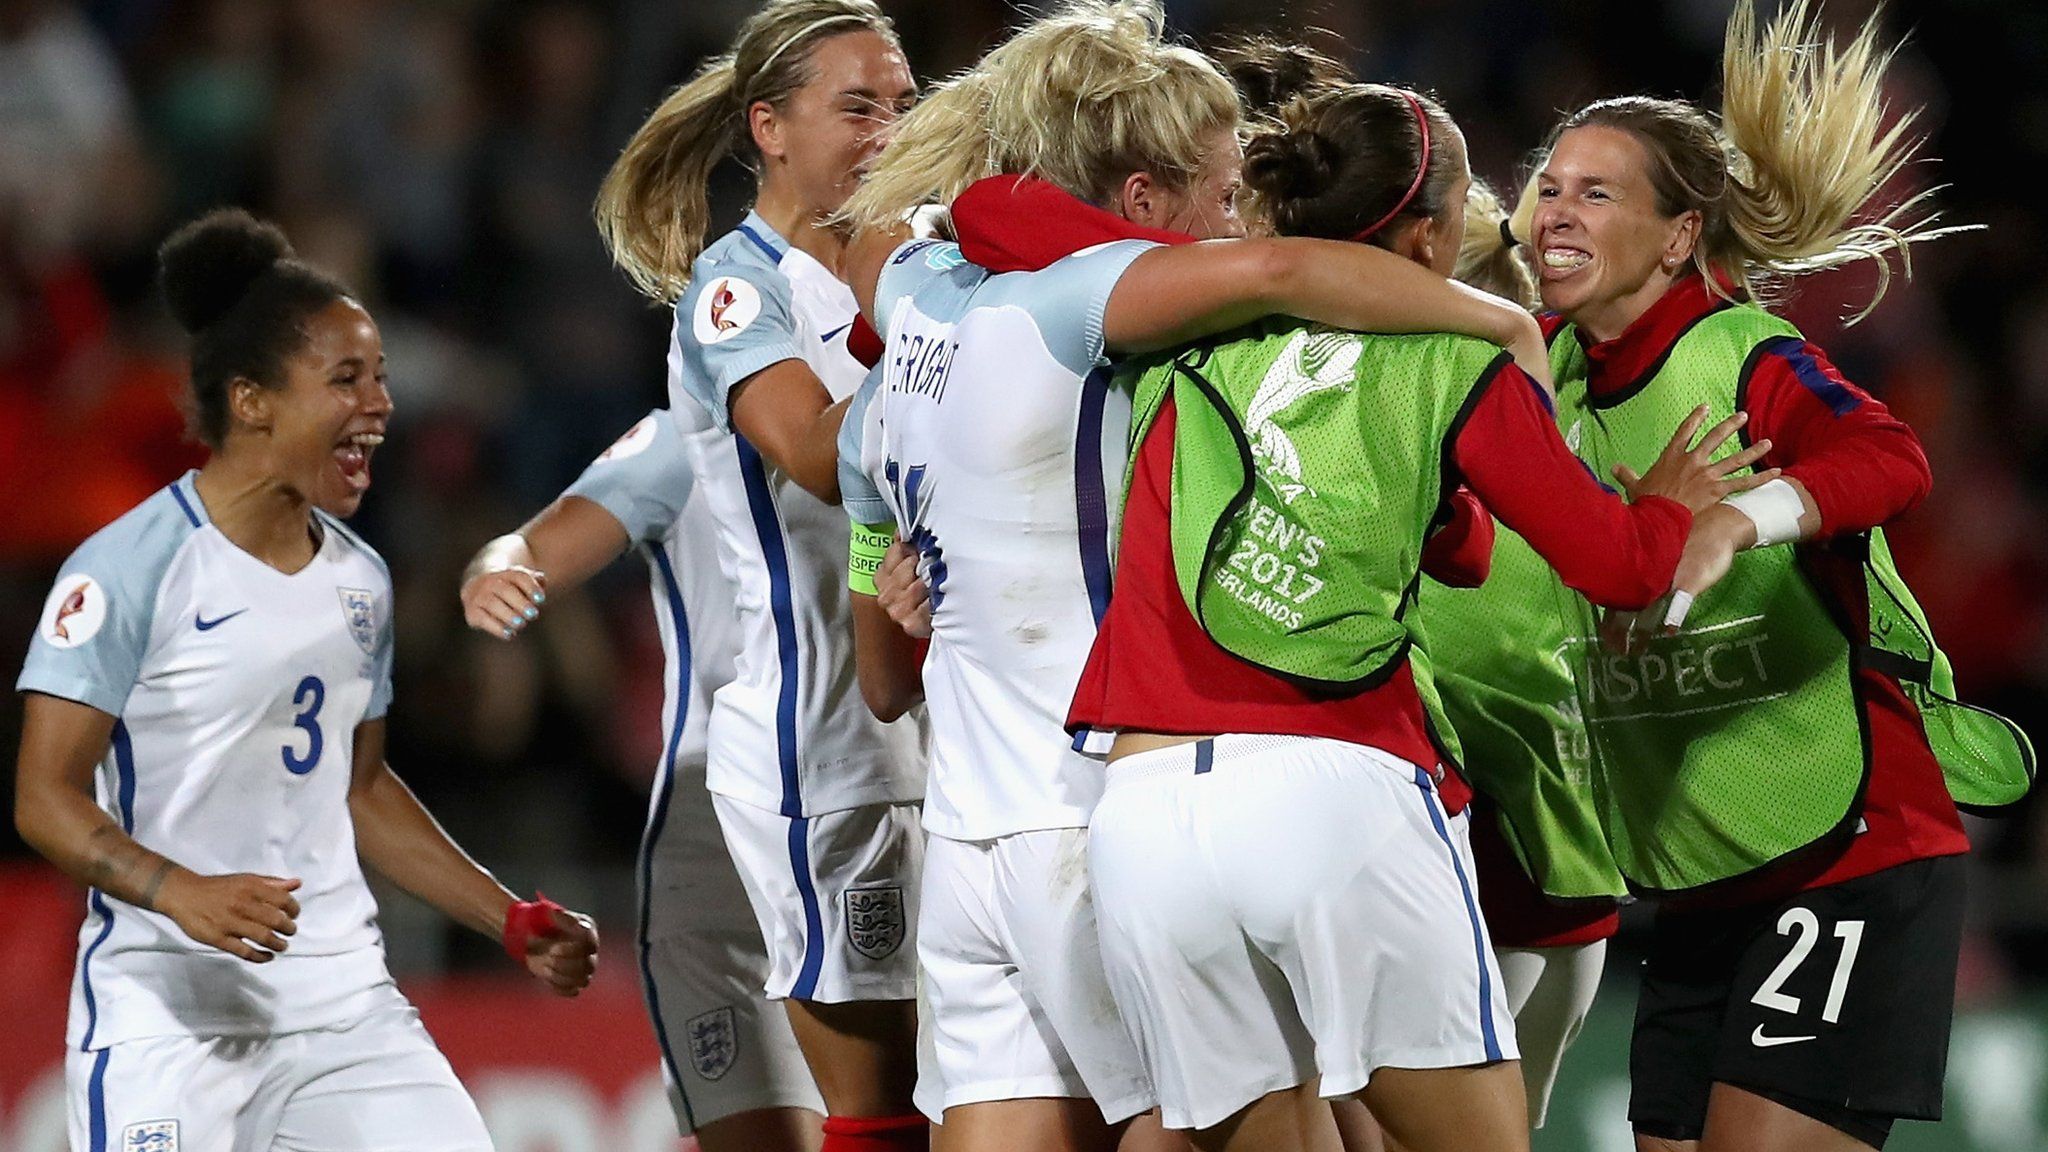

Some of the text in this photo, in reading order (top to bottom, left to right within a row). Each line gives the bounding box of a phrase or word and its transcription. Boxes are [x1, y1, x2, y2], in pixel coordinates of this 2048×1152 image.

[855, 532, 895, 549] RACIS
[1248, 497, 1326, 567] EN'S
[1214, 568, 1304, 629] ERLANDS
[1229, 540, 1324, 604] 2017
[1587, 633, 1768, 704] SPECT
[281, 675, 326, 775] 3
[1750, 907, 1865, 1023] 21
